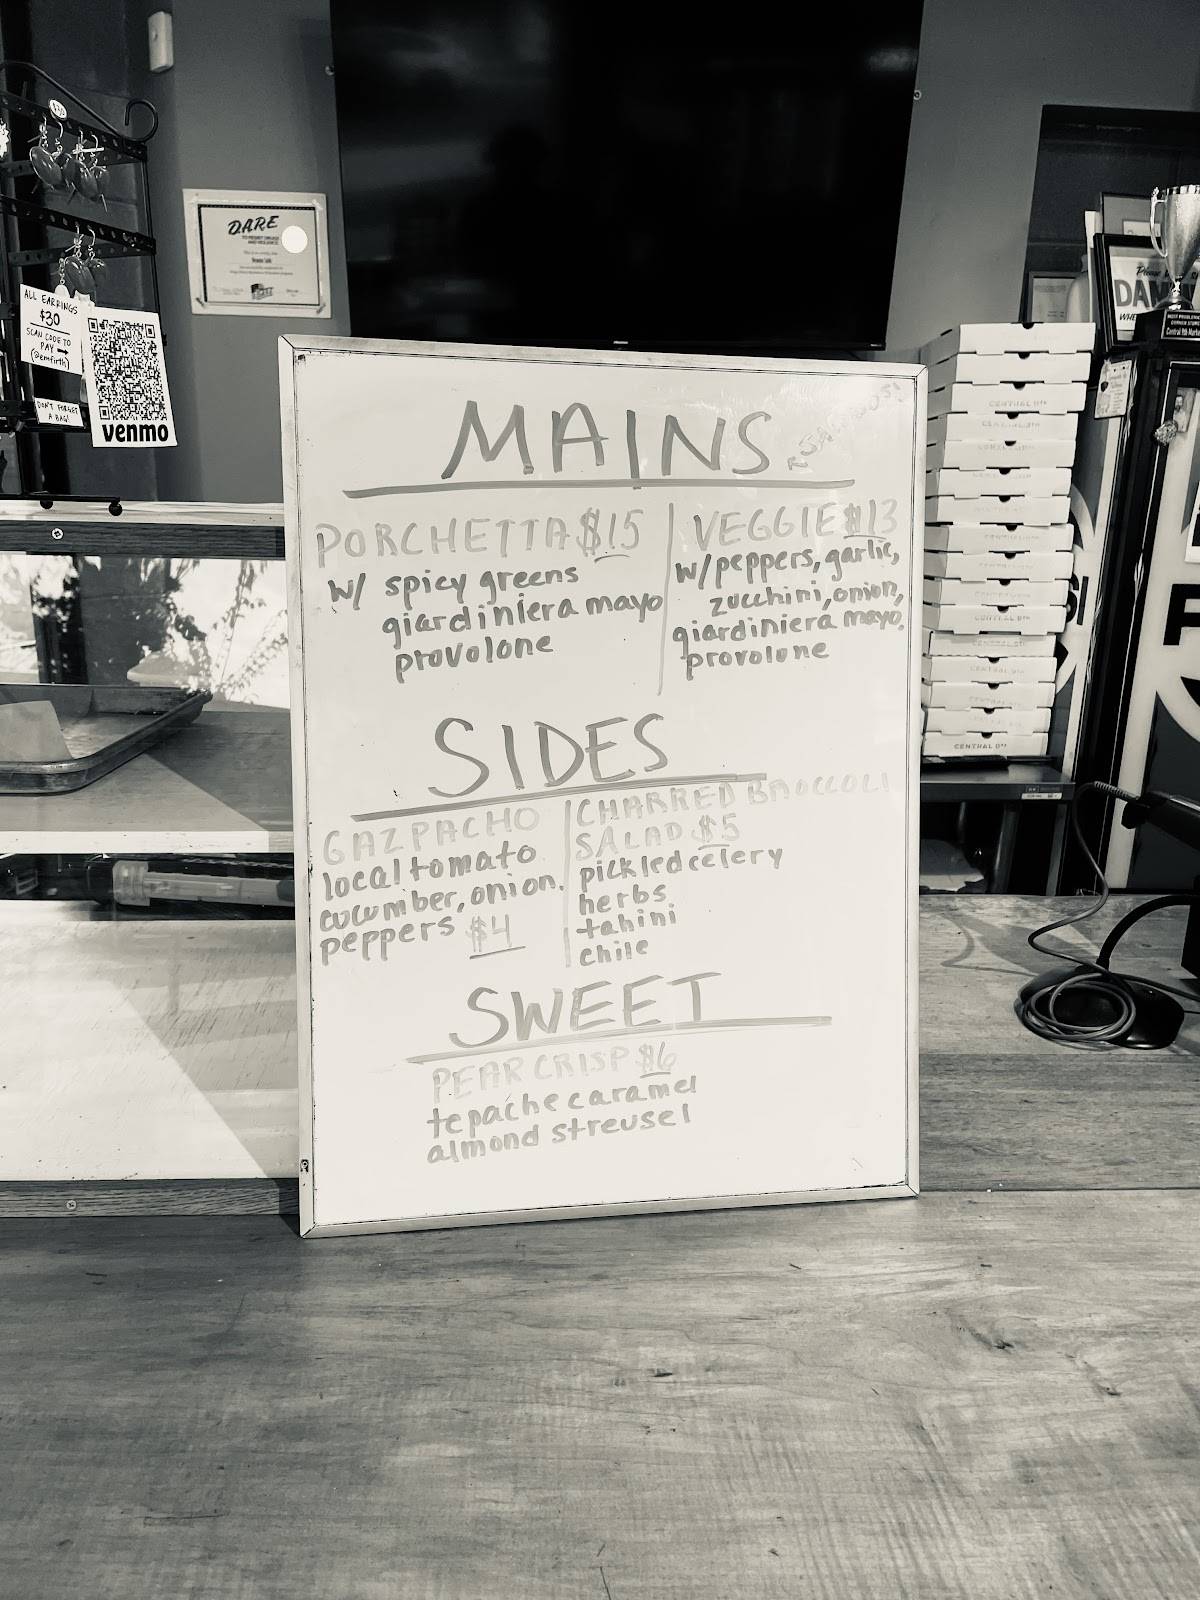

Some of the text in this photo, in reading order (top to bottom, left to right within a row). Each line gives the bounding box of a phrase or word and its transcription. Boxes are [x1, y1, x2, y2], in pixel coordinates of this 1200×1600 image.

[24, 288, 78, 315] ALL EARRINGS
[39, 308, 60, 327] $30
[26, 327, 72, 347] SCAN CODE TO
[40, 341, 54, 353] PAY
[37, 400, 79, 415] DON'T FORGET
[102, 423, 169, 443] venmo
[441, 400, 771, 480] MAINS
[315, 507, 644, 568] PORCHETTA $15
[693, 499, 898, 551] VEGGIE $13
[824, 539, 900, 581] garlic,
[328, 566, 579, 611] w/ spicy greens
[382, 592, 663, 650] giardiniera mayo
[672, 614, 837, 660] giardiniera
[395, 635, 553, 684] provolone
[686, 642, 829, 681] provolone
[428, 712, 668, 797] SIDES
[577, 782, 736, 827] CHARRED
[323, 807, 540, 865] GAZPACHO
[575, 813, 740, 862] SALAD $5
[323, 841, 537, 901] local tomato
[580, 848, 784, 893] pickled celery
[576, 903, 677, 939] tahini
[579, 884, 667, 916] herbs
[319, 914, 513, 966] peppers $4
[579, 940, 649, 967] chile
[449, 972, 722, 1049] SWEET
[432, 1041, 677, 1103] PEAR CRISP $6
[426, 1075, 698, 1139] tepache caramel
[427, 1103, 691, 1164] almond streusel
